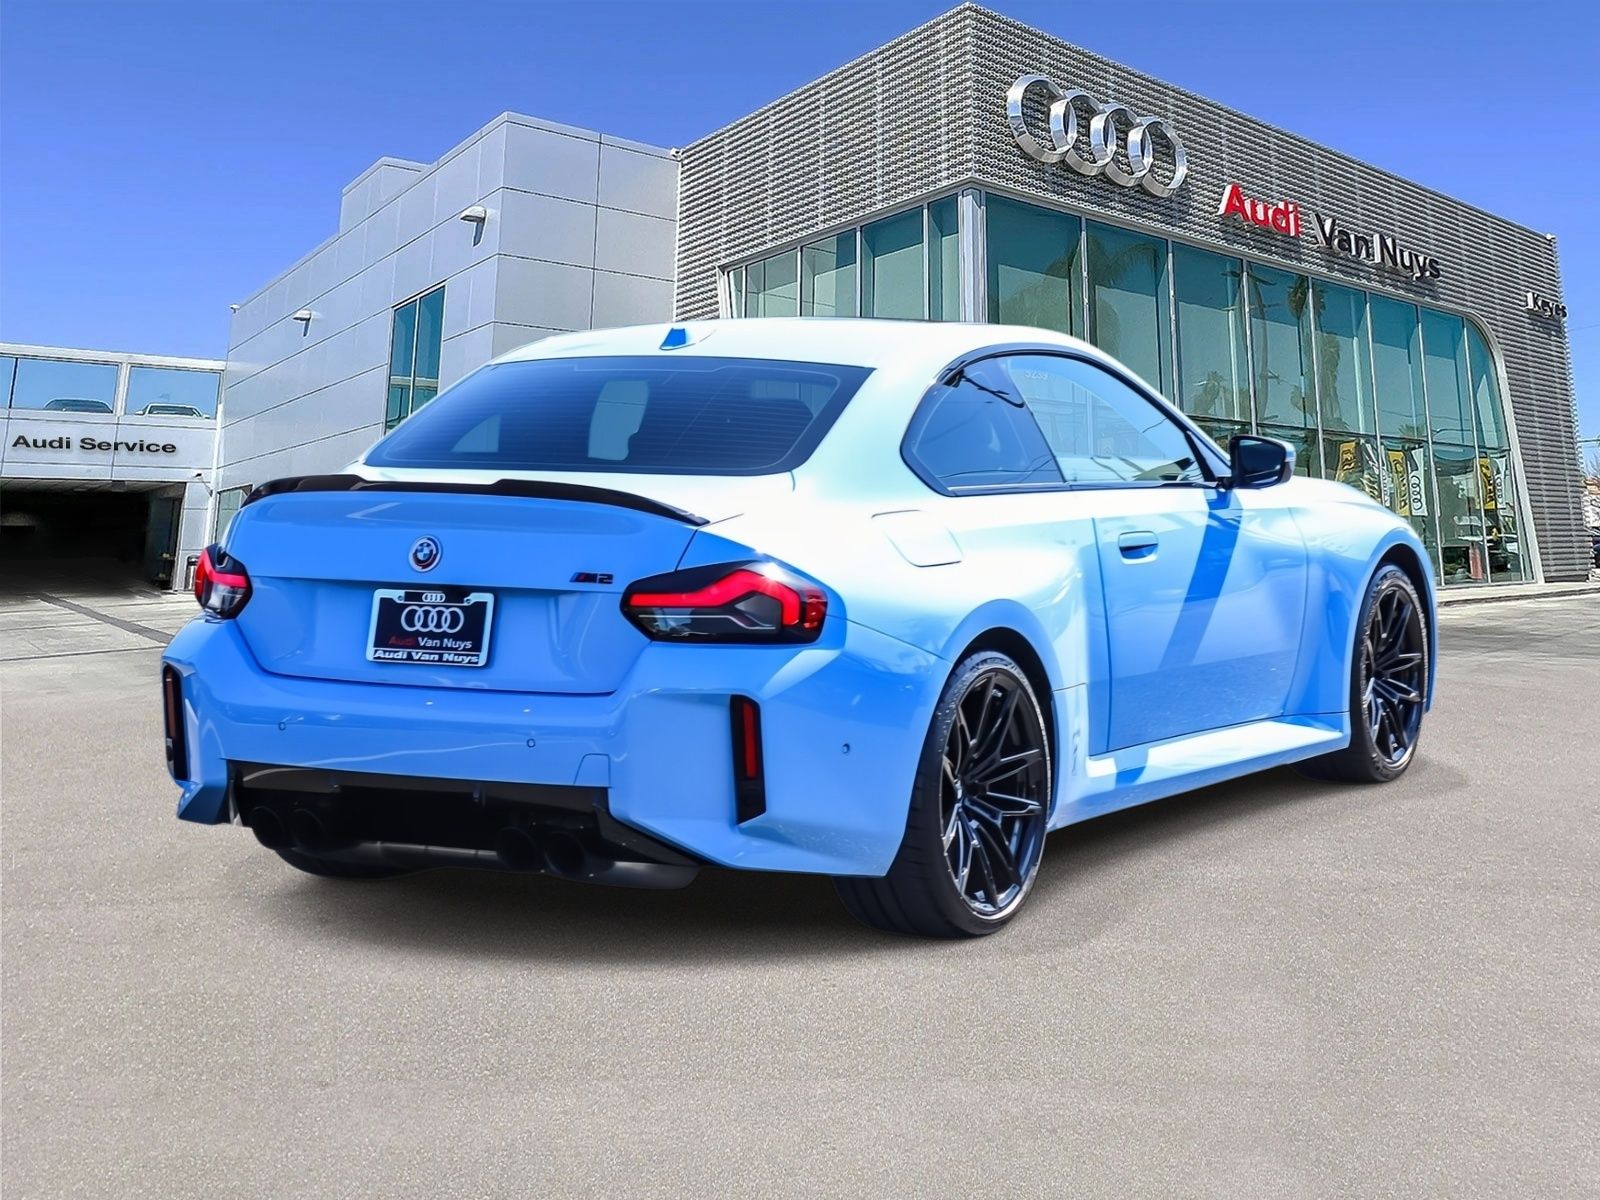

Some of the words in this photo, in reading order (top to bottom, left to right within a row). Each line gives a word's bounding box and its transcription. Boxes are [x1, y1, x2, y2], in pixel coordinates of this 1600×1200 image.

[1217, 183, 1301, 238] Audi
[1310, 212, 1370, 259] Van
[1373, 233, 1440, 281] Nuys
[1525, 291, 1567, 319] Keyes
[12, 434, 71, 449] Audi
[79, 437, 177, 453] Service
[388, 635, 416, 647] Audi
[417, 636, 440, 647] Van
[443, 638, 472, 650] Nuys
[374, 650, 407, 659] Audi
[411, 651, 439, 661] Van
[443, 653, 479, 664] Nuys
